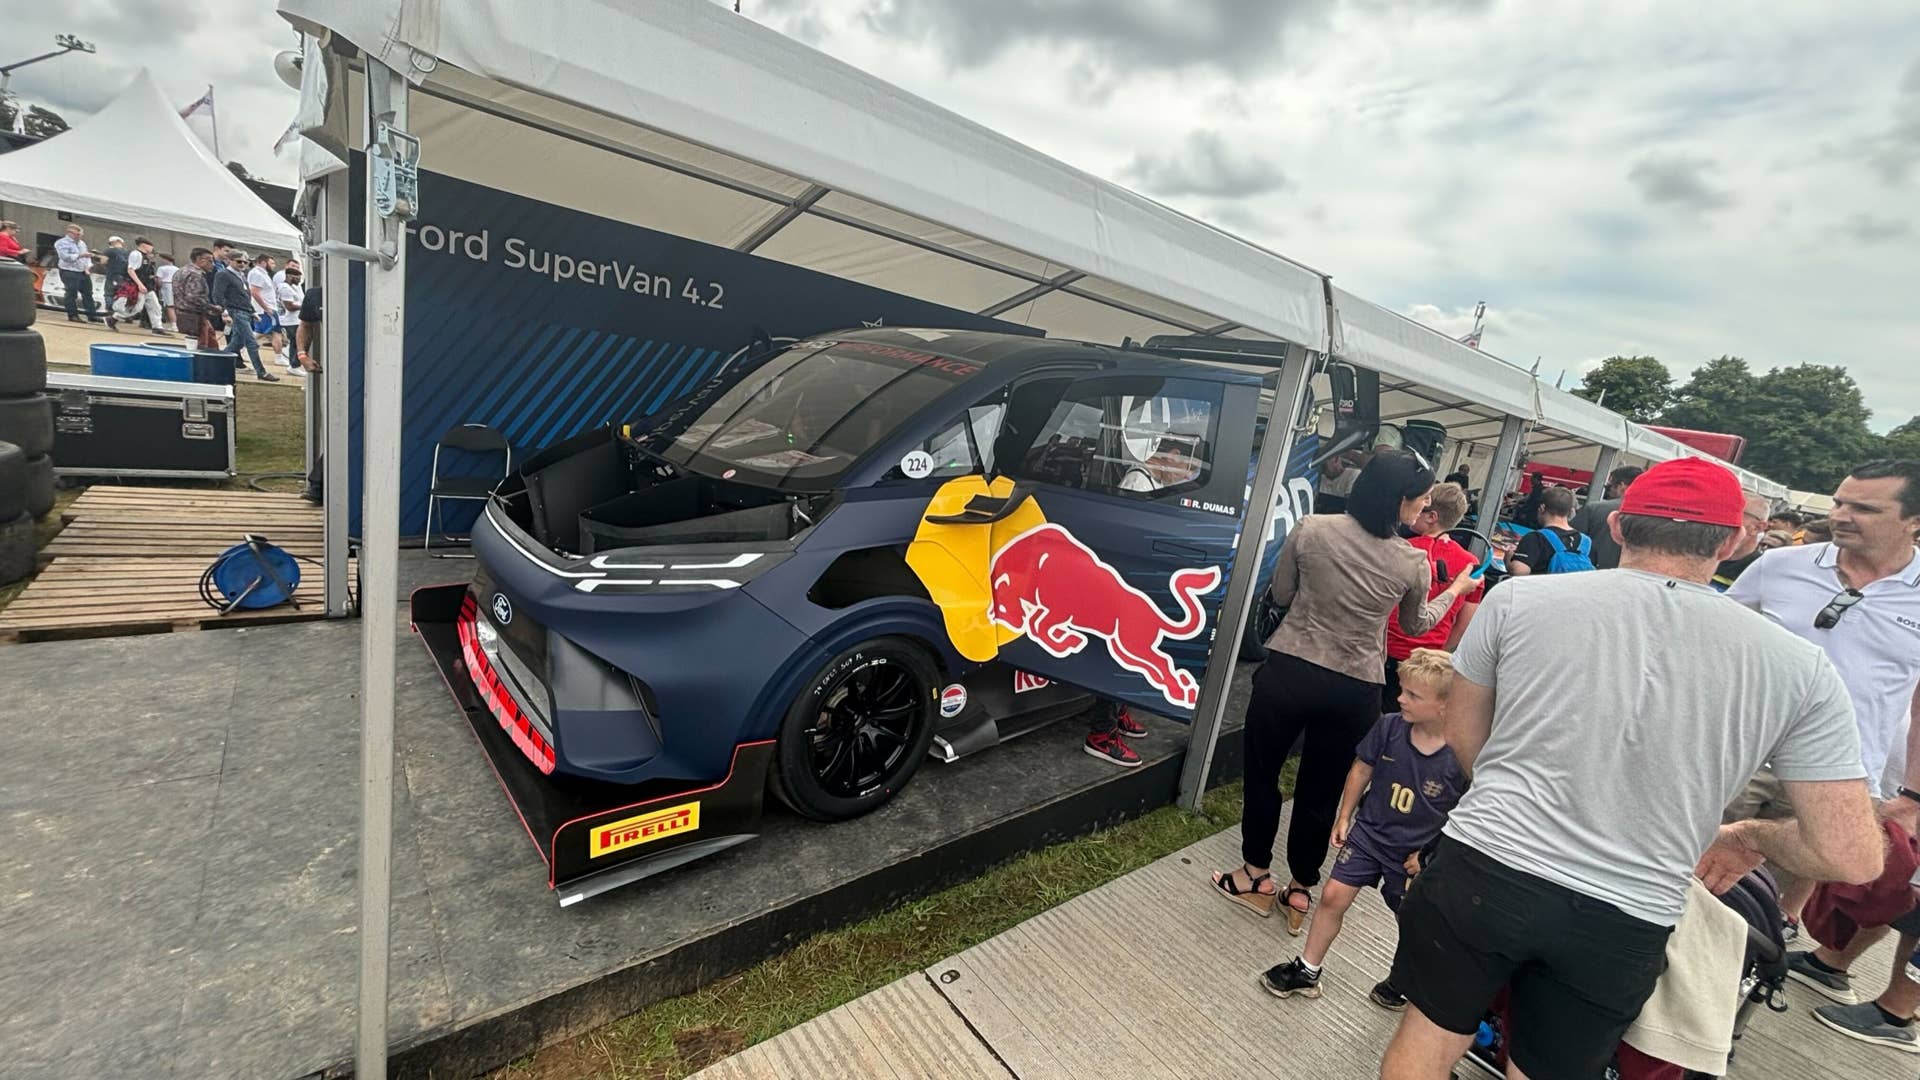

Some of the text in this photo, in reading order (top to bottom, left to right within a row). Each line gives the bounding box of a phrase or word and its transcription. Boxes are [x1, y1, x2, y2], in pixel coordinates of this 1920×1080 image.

[503, 238, 671, 299] SuperVan
[681, 278, 724, 309] 4.2
[907, 458, 928, 472] 224
[1192, 500, 1236, 515] R. DUMAS
[1390, 783, 1415, 814] 10
[600, 809, 691, 849] PIRELLI
